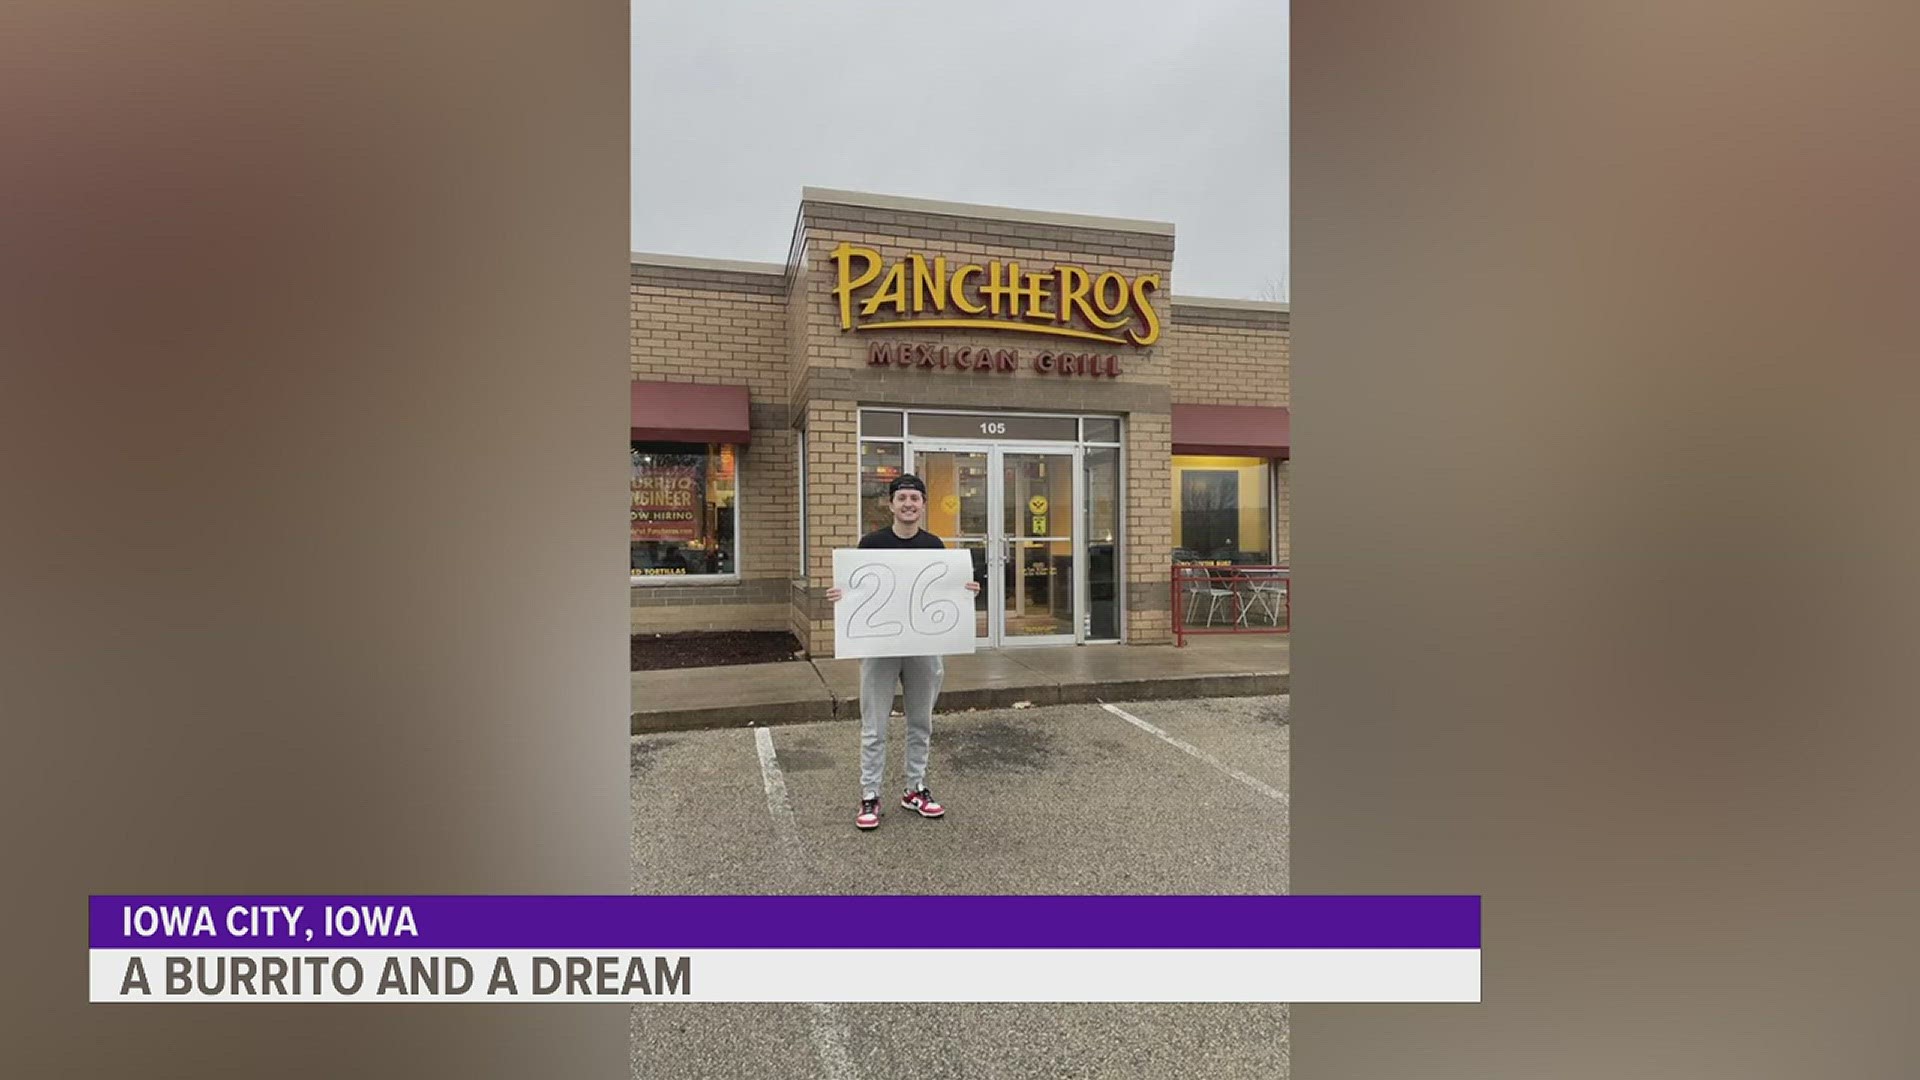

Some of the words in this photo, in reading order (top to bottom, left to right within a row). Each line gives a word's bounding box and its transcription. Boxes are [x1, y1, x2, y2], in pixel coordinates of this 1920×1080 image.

[830, 241, 1161, 346] PANCHEROS
[867, 341, 1018, 374] MEXICAN
[1035, 350, 1124, 377] GRILL
[979, 422, 1006, 434] 105
[631, 476, 692, 489] URRITO
[631, 490, 692, 506] NGINEER
[630, 511, 650, 520] OW
[653, 511, 693, 520] HIRING
[846, 561, 960, 640] 26
